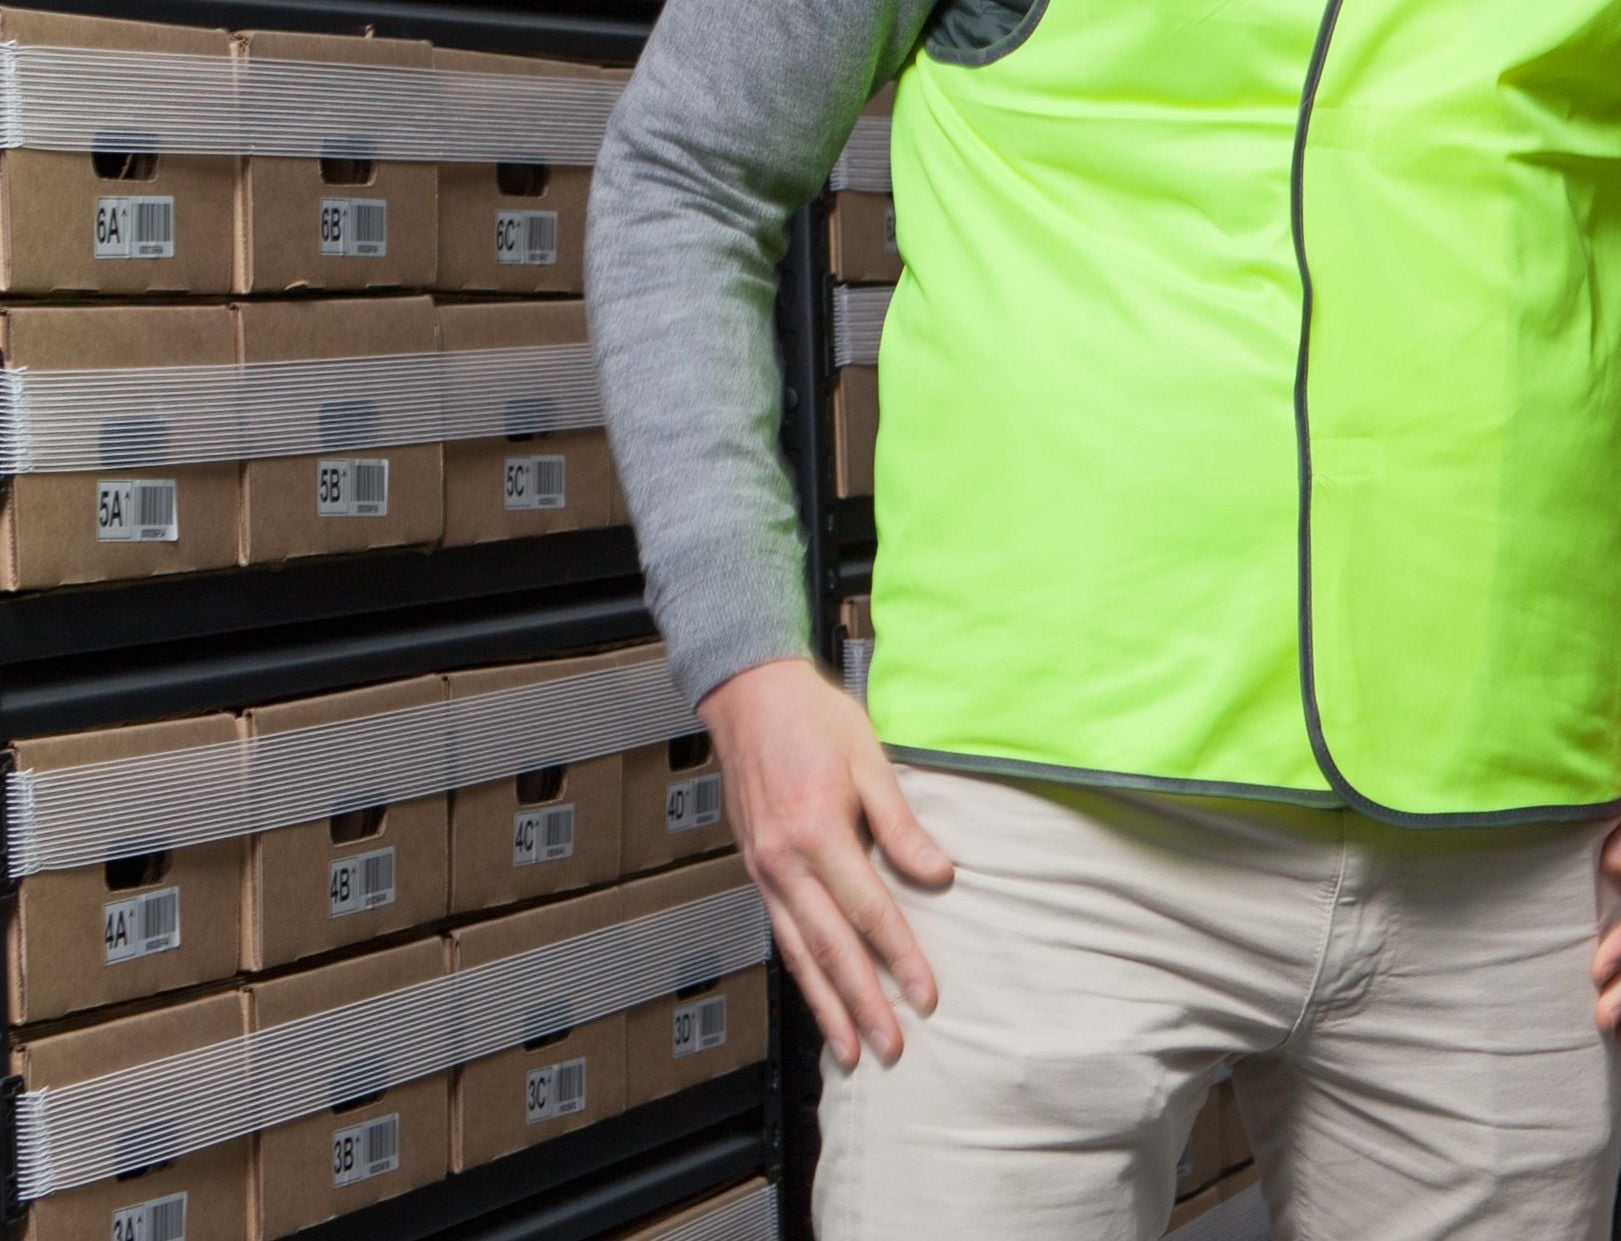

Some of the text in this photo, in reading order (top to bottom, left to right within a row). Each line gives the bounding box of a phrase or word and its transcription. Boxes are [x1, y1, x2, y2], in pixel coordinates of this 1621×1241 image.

[97, 207, 121, 244] 6A
[321, 208, 342, 242] 6B
[496, 219, 515, 251] 6C
[319, 469, 341, 503] 5B
[506, 465, 525, 497] 5C
[99, 490, 123, 527] 5A
[667, 790, 685, 821] 4D
[515, 820, 534, 853] 4C
[330, 867, 350, 904] 4B
[105, 909, 128, 950] 4A
[674, 1014, 691, 1046] 3D
[528, 1077, 547, 1111] 3C
[333, 1136, 354, 1174] 3B
